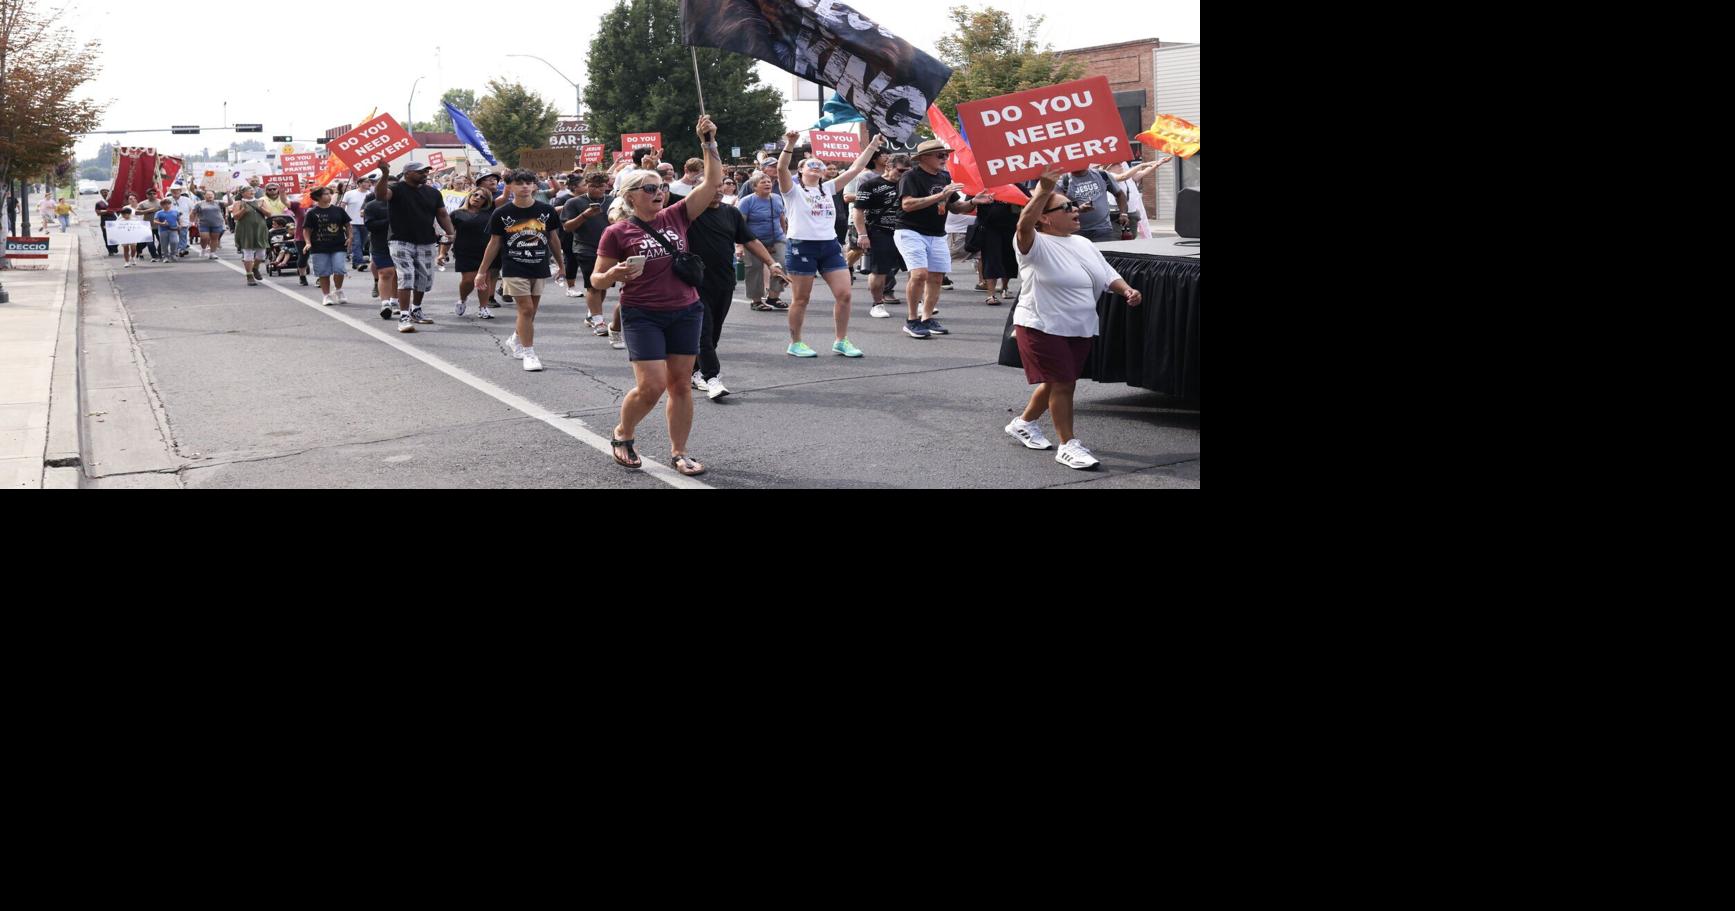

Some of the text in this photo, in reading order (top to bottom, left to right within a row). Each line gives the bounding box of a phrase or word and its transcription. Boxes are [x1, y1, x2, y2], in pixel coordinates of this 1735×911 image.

[980, 90, 1093, 127] DO YOU
[338, 121, 388, 150] DO YOU
[354, 134, 391, 156] NEED
[832, 135, 854, 143] YOU
[1004, 118, 1086, 147] NEED
[353, 137, 410, 171] PRAYER?
[816, 150, 860, 159] PRAYER?
[986, 136, 1119, 176] PRAYER?
[1075, 182, 1099, 194] JESUS
